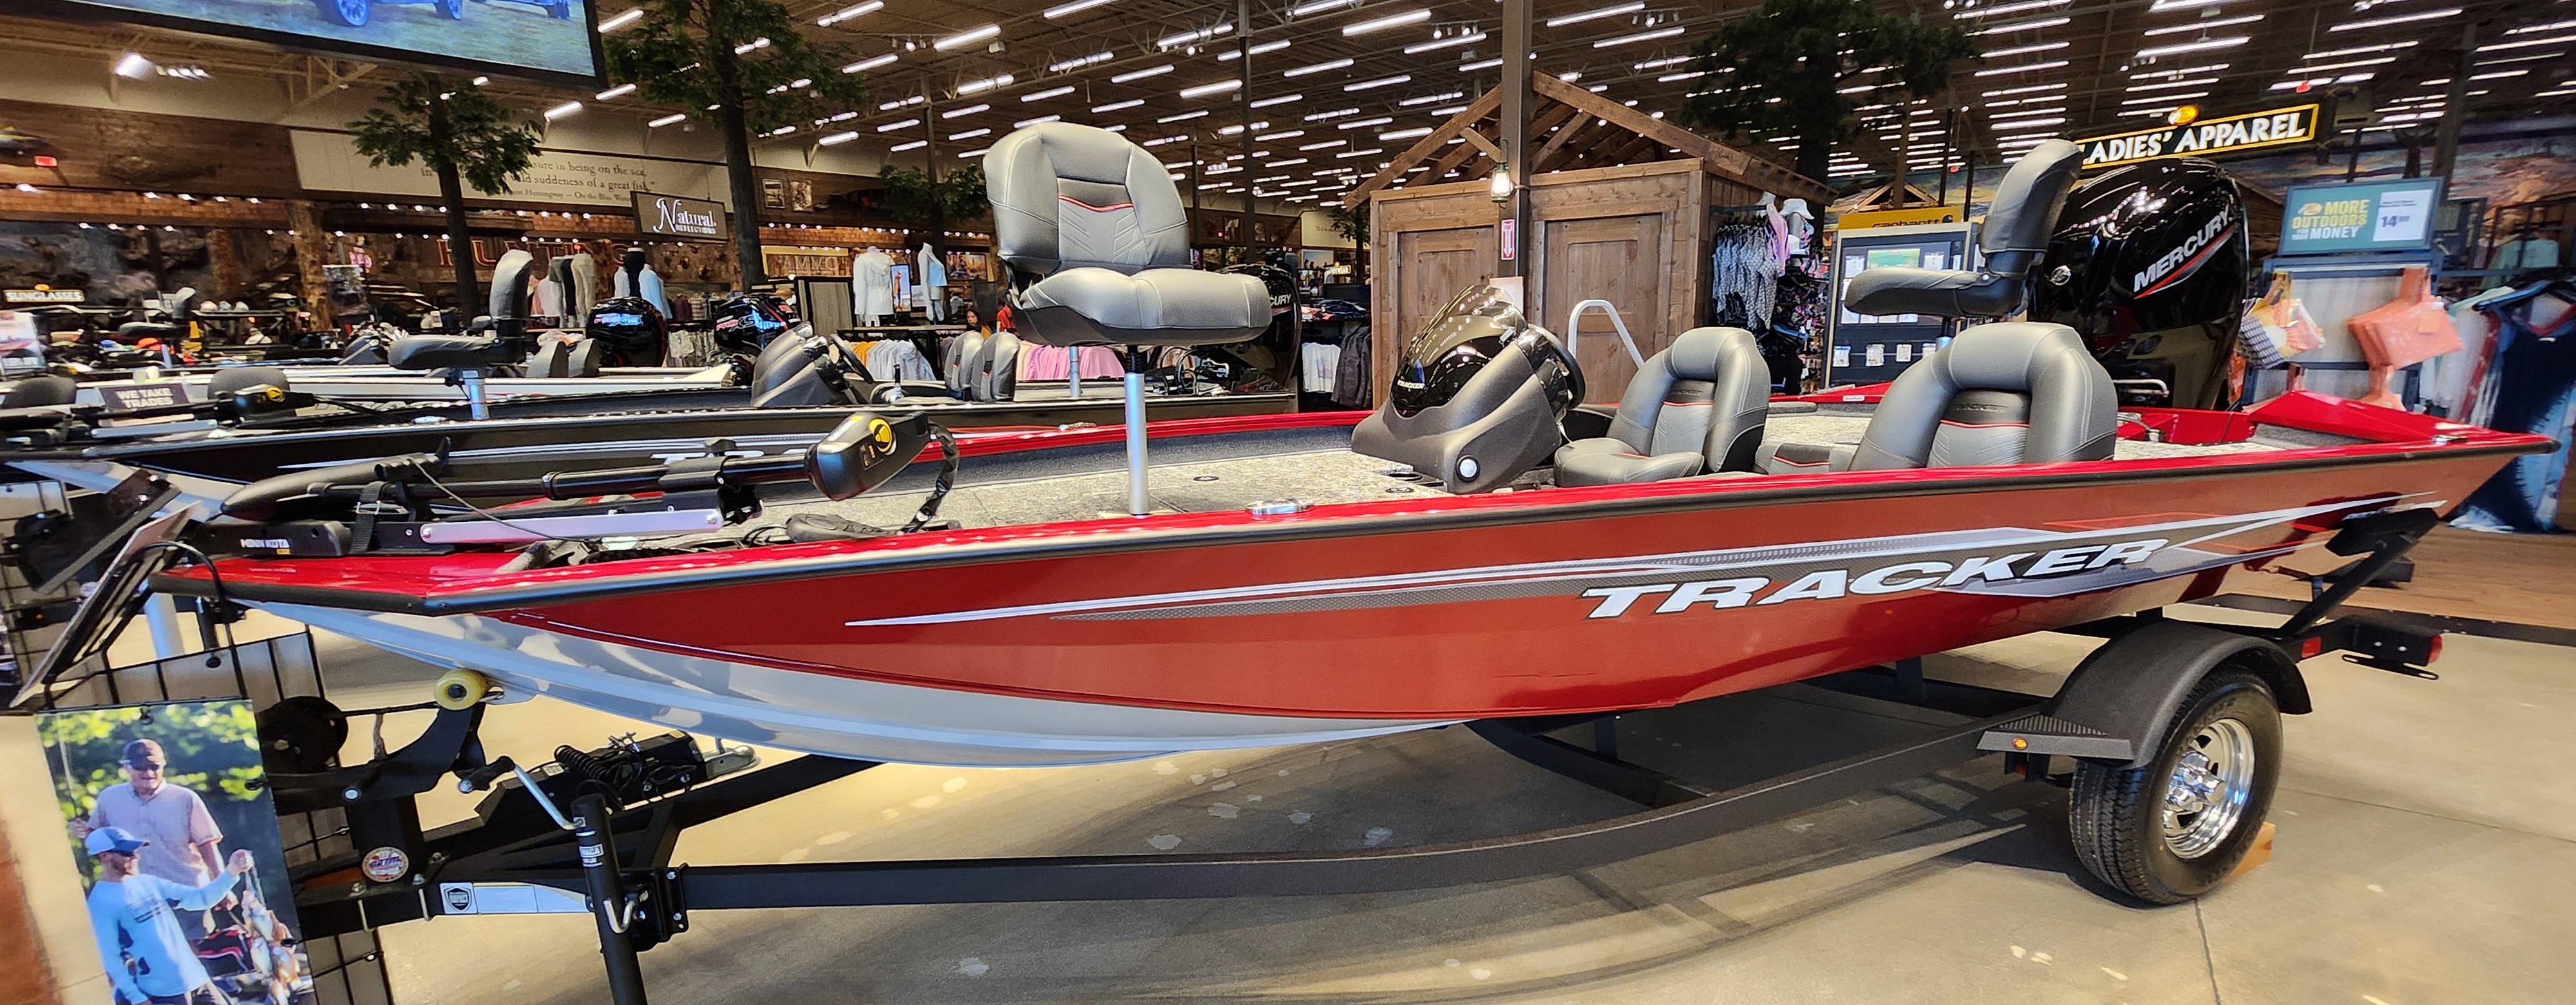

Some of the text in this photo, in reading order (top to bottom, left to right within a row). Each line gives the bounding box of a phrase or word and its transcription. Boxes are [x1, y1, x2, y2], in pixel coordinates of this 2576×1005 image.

[2175, 112, 2306, 153] APPAREL
[568, 161, 596, 177] being
[612, 164, 628, 175] the
[587, 177, 596, 187] of
[608, 182, 630, 193] great
[2324, 199, 2371, 215] MORE
[653, 198, 715, 233] Natural
[2291, 213, 2368, 229] OUTDOORS
[2309, 225, 2360, 240] MONEY
[2134, 204, 2229, 292] MERCURY
[781, 255, 837, 271] AMMO
[5, 291, 82, 301] SUNGLASSES
[1270, 294, 1292, 307] CURY
[116, 387, 173, 400] WE TAKE
[121, 396, 174, 408] TRADES
[1582, 539, 2170, 619] TRACKER
